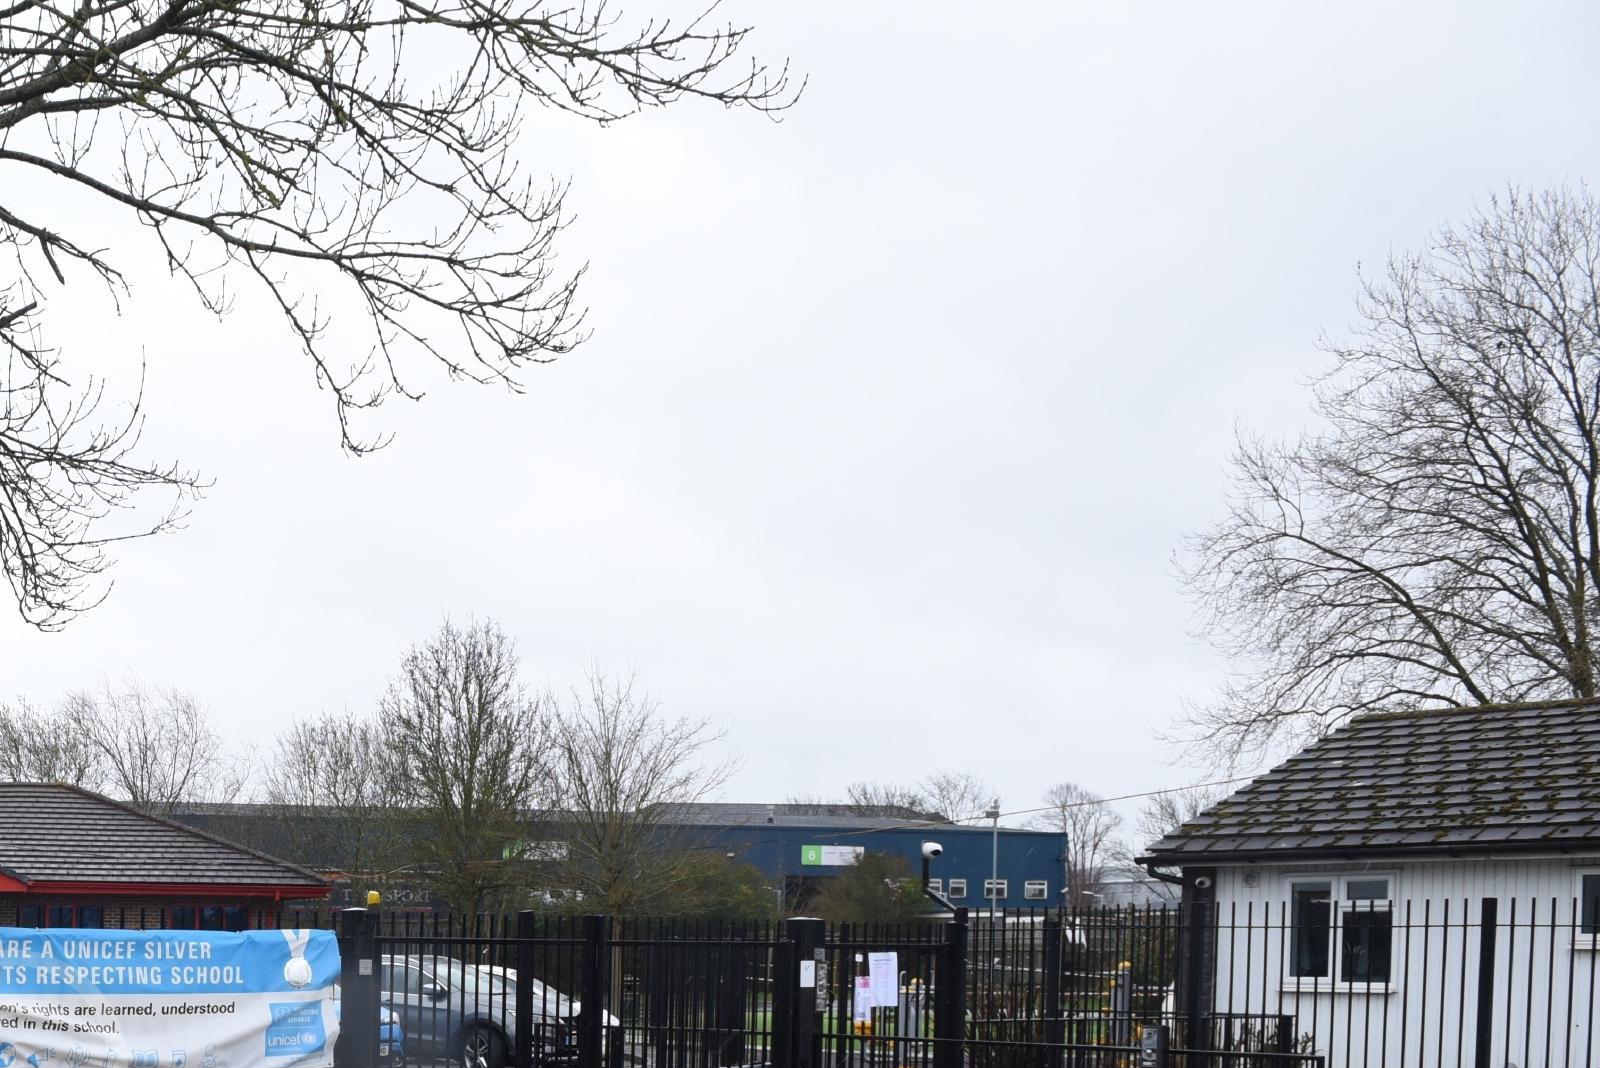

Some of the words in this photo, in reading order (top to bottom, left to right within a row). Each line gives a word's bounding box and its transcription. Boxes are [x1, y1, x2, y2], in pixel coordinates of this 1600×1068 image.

[808, 850, 816, 861] 6
[41, 940, 54, 959] A
[63, 940, 136, 960] UNICEF
[144, 941, 211, 960] SILVER
[36, 966, 162, 985] RESPECTING
[171, 966, 244, 985] SCHOOL
[31, 1003, 70, 1017] rights
[74, 1005, 97, 1016] are
[101, 1003, 156, 1017] learned,
[161, 1001, 235, 1016] understood
[23, 1018, 37, 1030] in
[42, 1019, 69, 1032] this
[74, 1021, 119, 1034] school.
[269, 1032, 301, 1046] unicef
